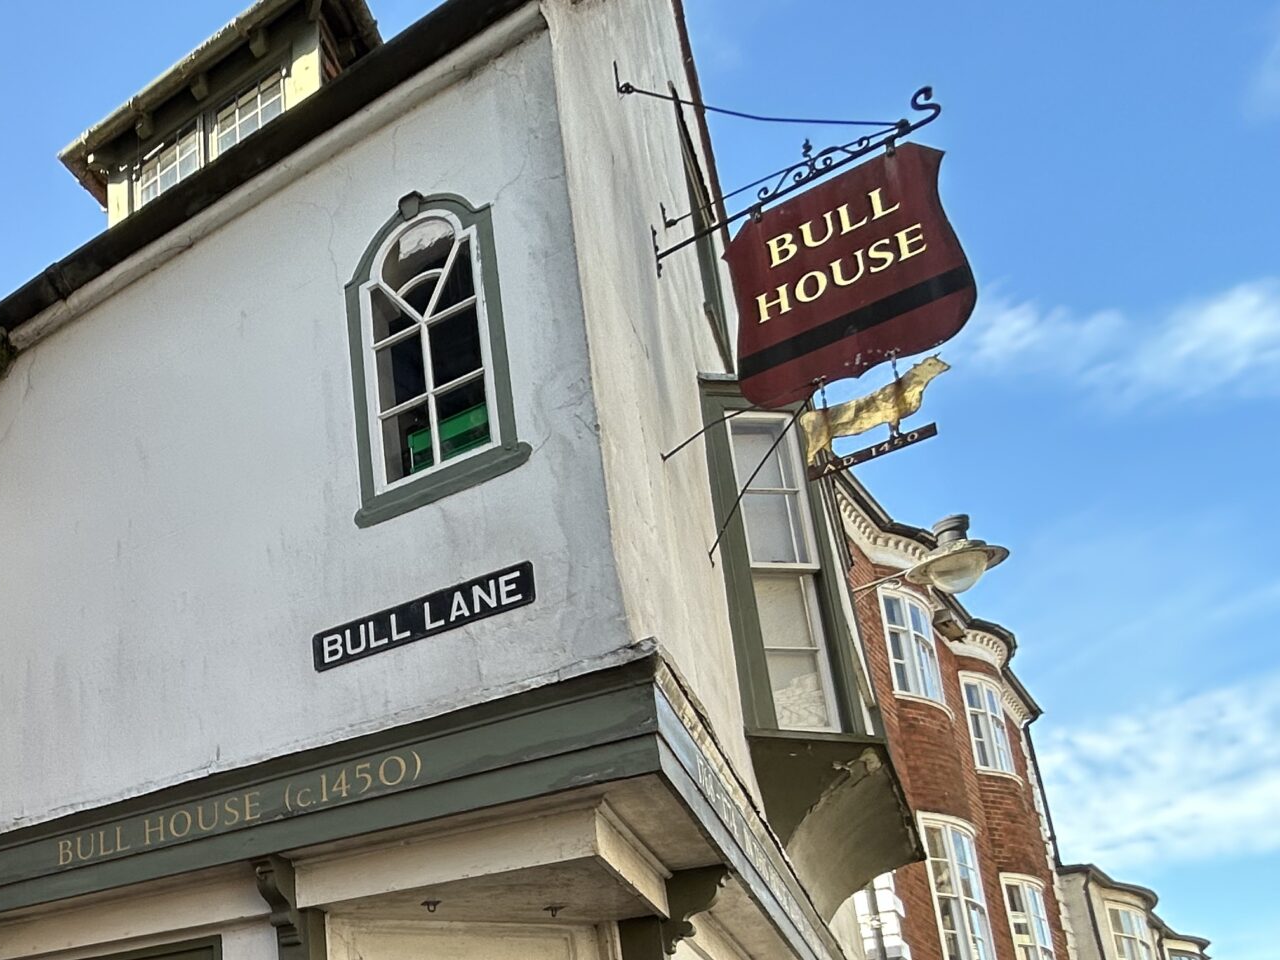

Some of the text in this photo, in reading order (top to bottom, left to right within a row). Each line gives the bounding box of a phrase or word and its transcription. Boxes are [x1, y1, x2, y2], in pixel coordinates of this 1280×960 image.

[755, 223, 927, 324] HOUSE
[765, 187, 900, 268] BULL
[322, 570, 523, 663] BULL LANE
[57, 751, 422, 866] BULL HOUSE (c.1450)
